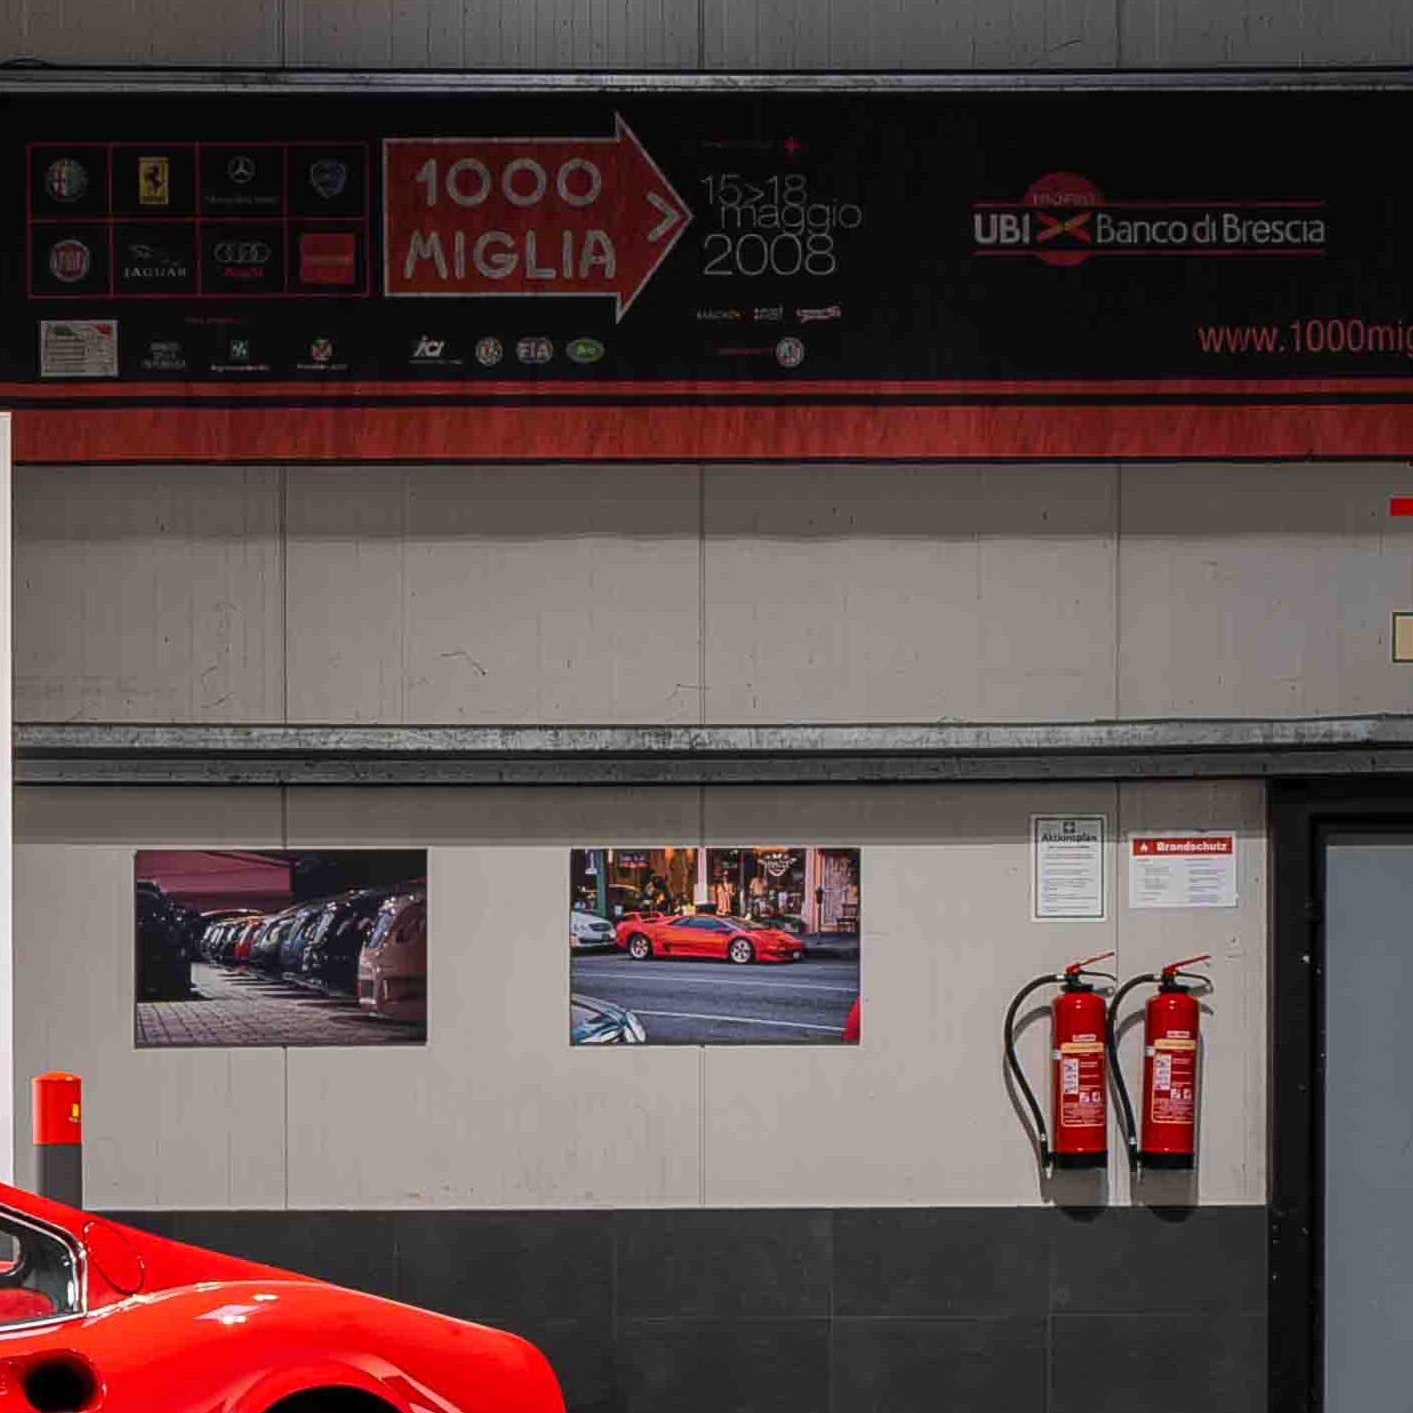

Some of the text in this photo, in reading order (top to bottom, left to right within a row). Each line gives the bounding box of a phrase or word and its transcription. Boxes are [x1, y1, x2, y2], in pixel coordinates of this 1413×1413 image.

[413, 157, 602, 208] 1000
[721, 197, 863, 237] maggio
[973, 213, 1326, 244] UBI Banco di Brescia
[403, 228, 618, 281] MIGLIA
[703, 233, 837, 276] 2008
[1156, 841, 1228, 852] Brandschutz
